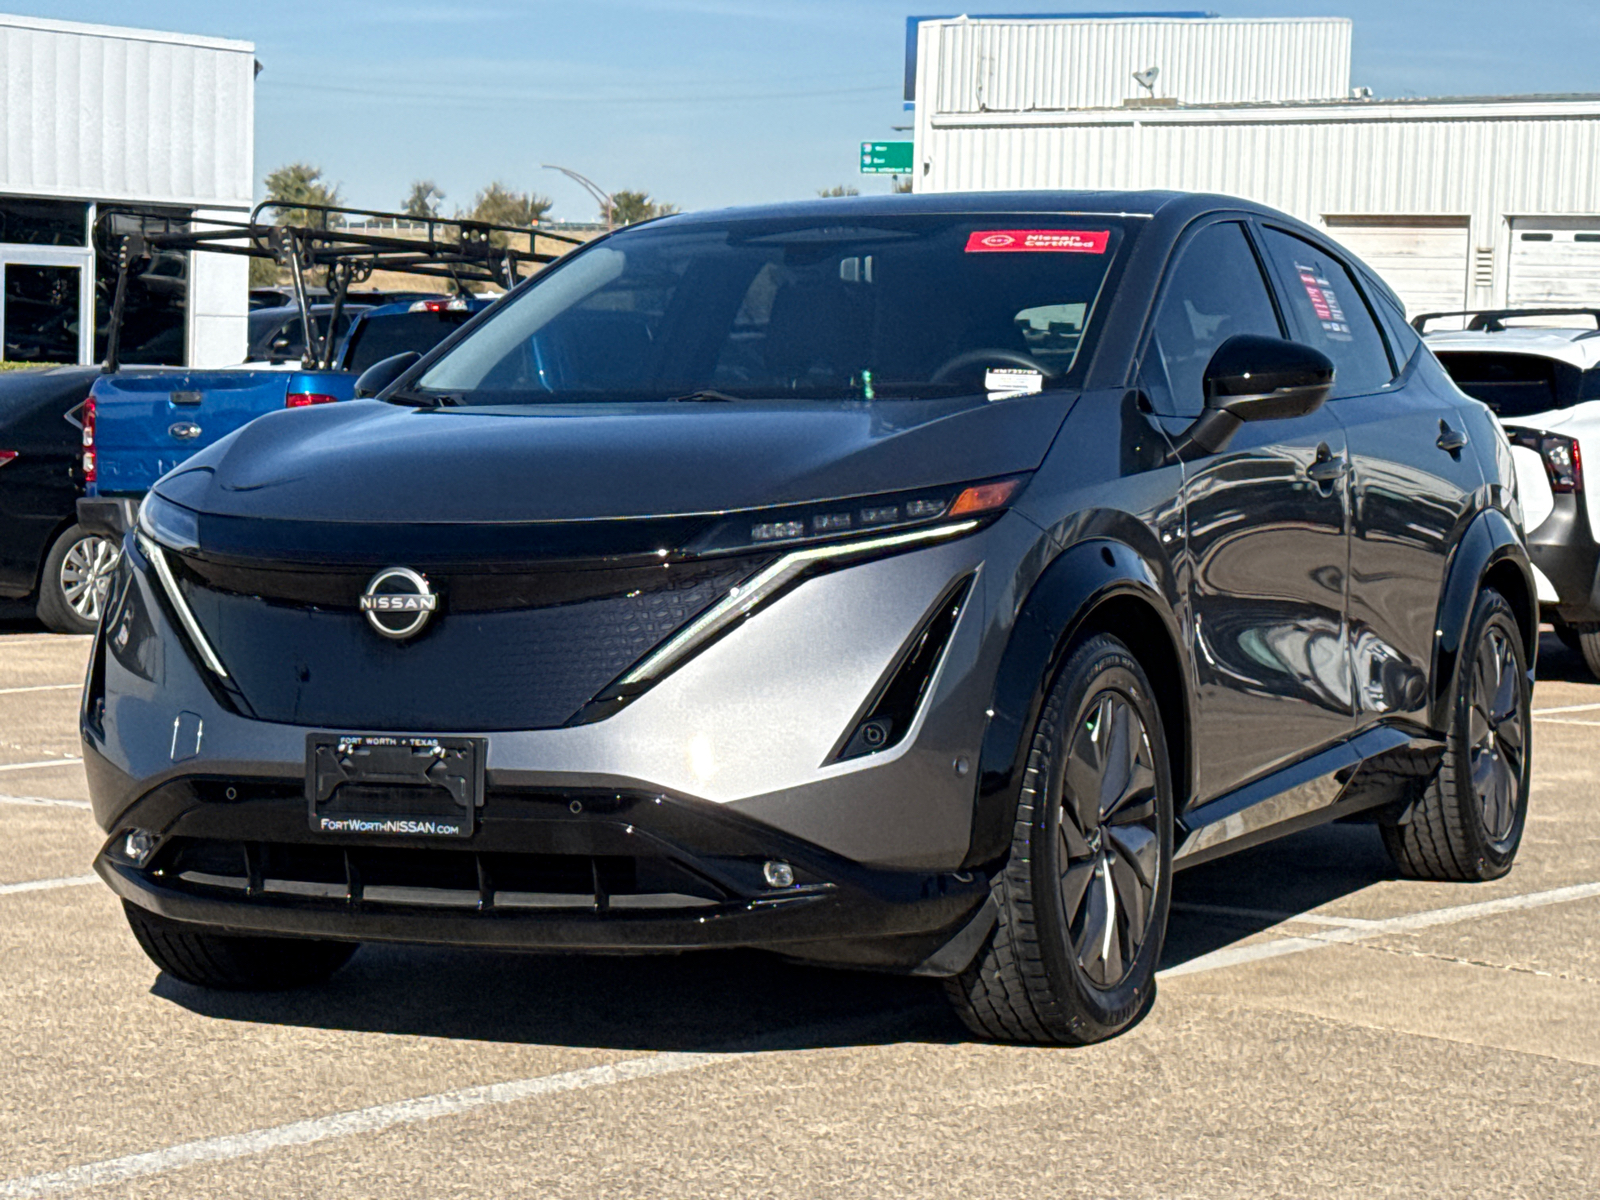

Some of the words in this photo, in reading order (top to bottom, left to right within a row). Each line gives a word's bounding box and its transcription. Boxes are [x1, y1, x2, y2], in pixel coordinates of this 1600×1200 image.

[1024, 240, 1094, 248] Certified
[361, 597, 433, 609] NISSAN
[340, 737, 363, 745] FORT
[366, 737, 397, 746] WORTH
[409, 738, 439, 747] TEXAS
